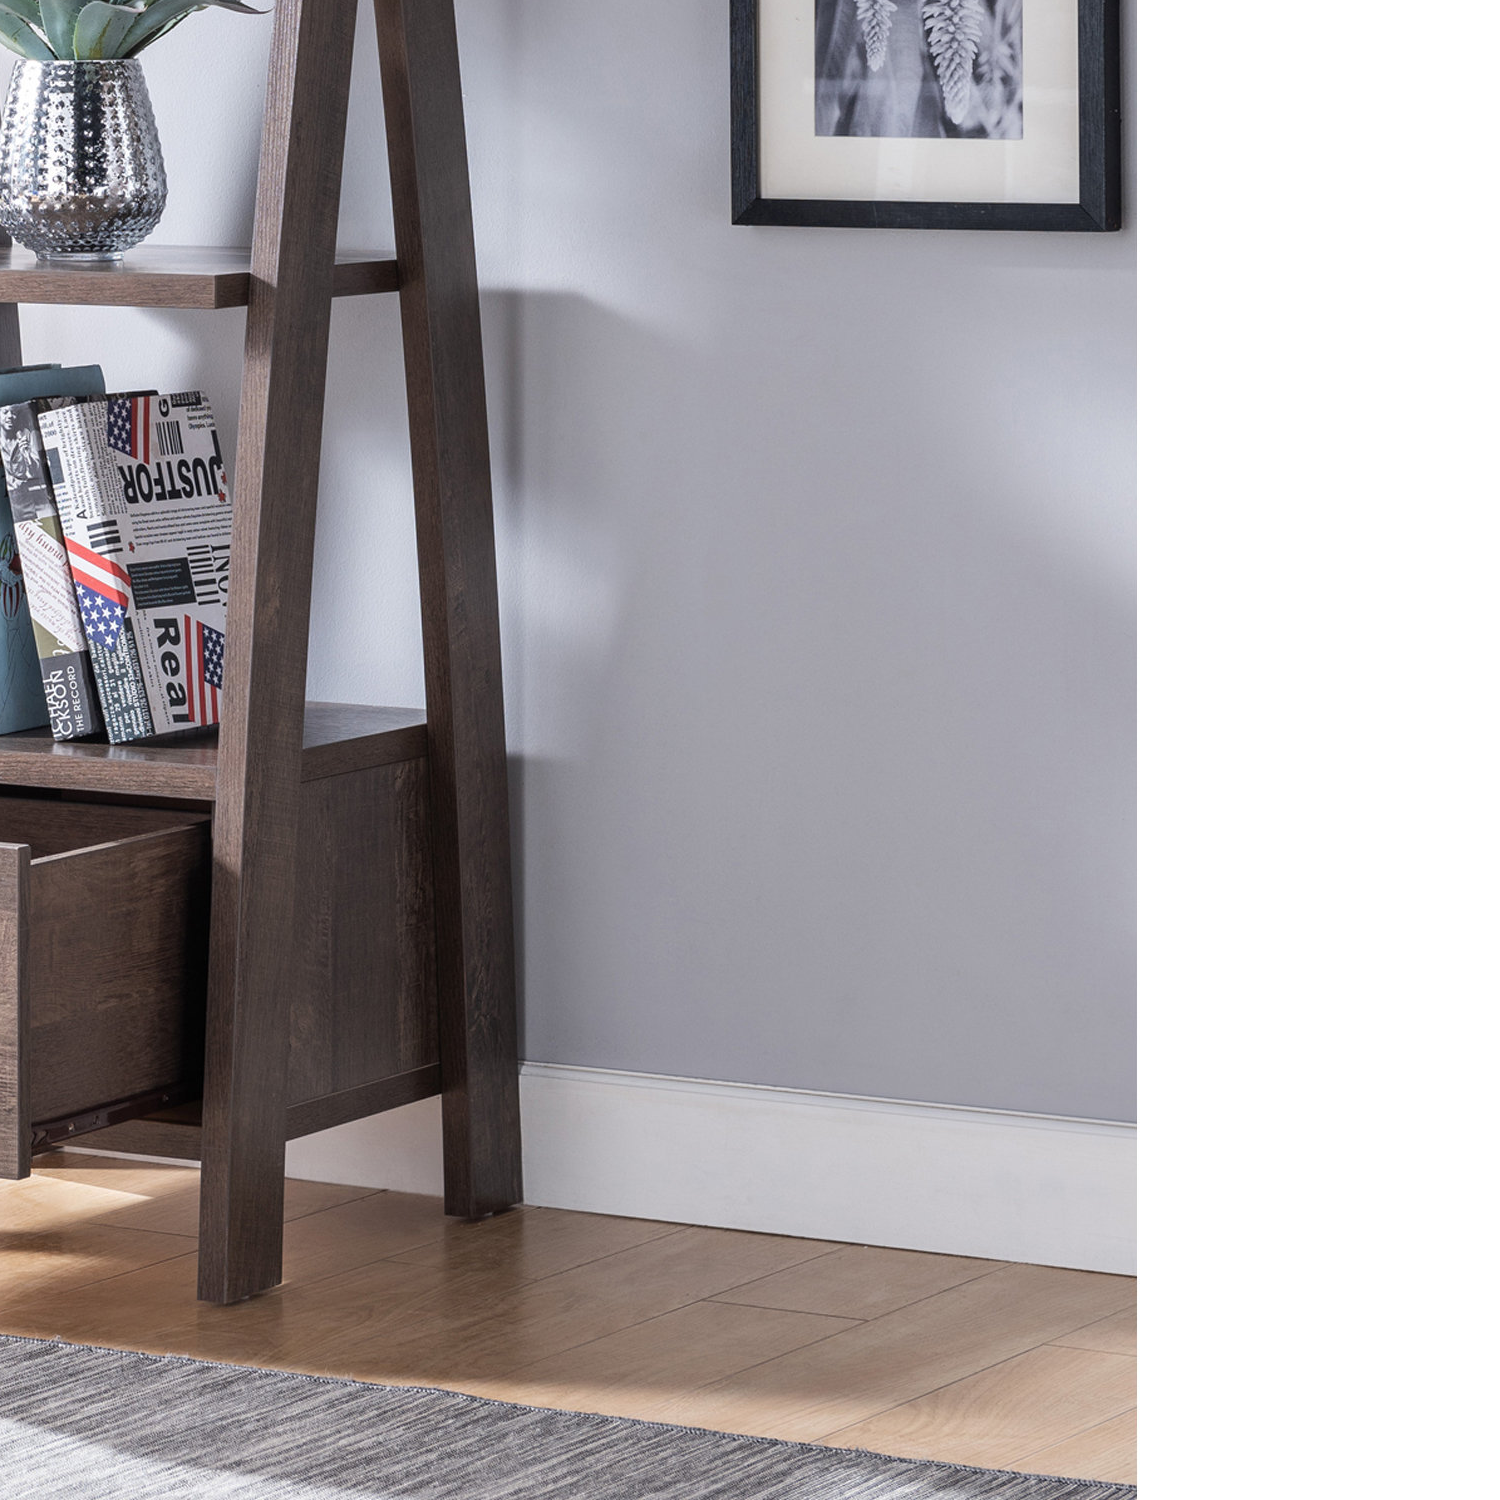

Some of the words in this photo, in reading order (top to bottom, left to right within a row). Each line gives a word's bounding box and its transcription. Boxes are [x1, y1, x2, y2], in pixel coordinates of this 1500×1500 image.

[67, 665, 82, 711] RECORD
[153, 618, 190, 723] Real
[42, 676, 62, 741] ICHAEL
[52, 669, 74, 740] CKSON
[75, 713, 85, 731] THE
